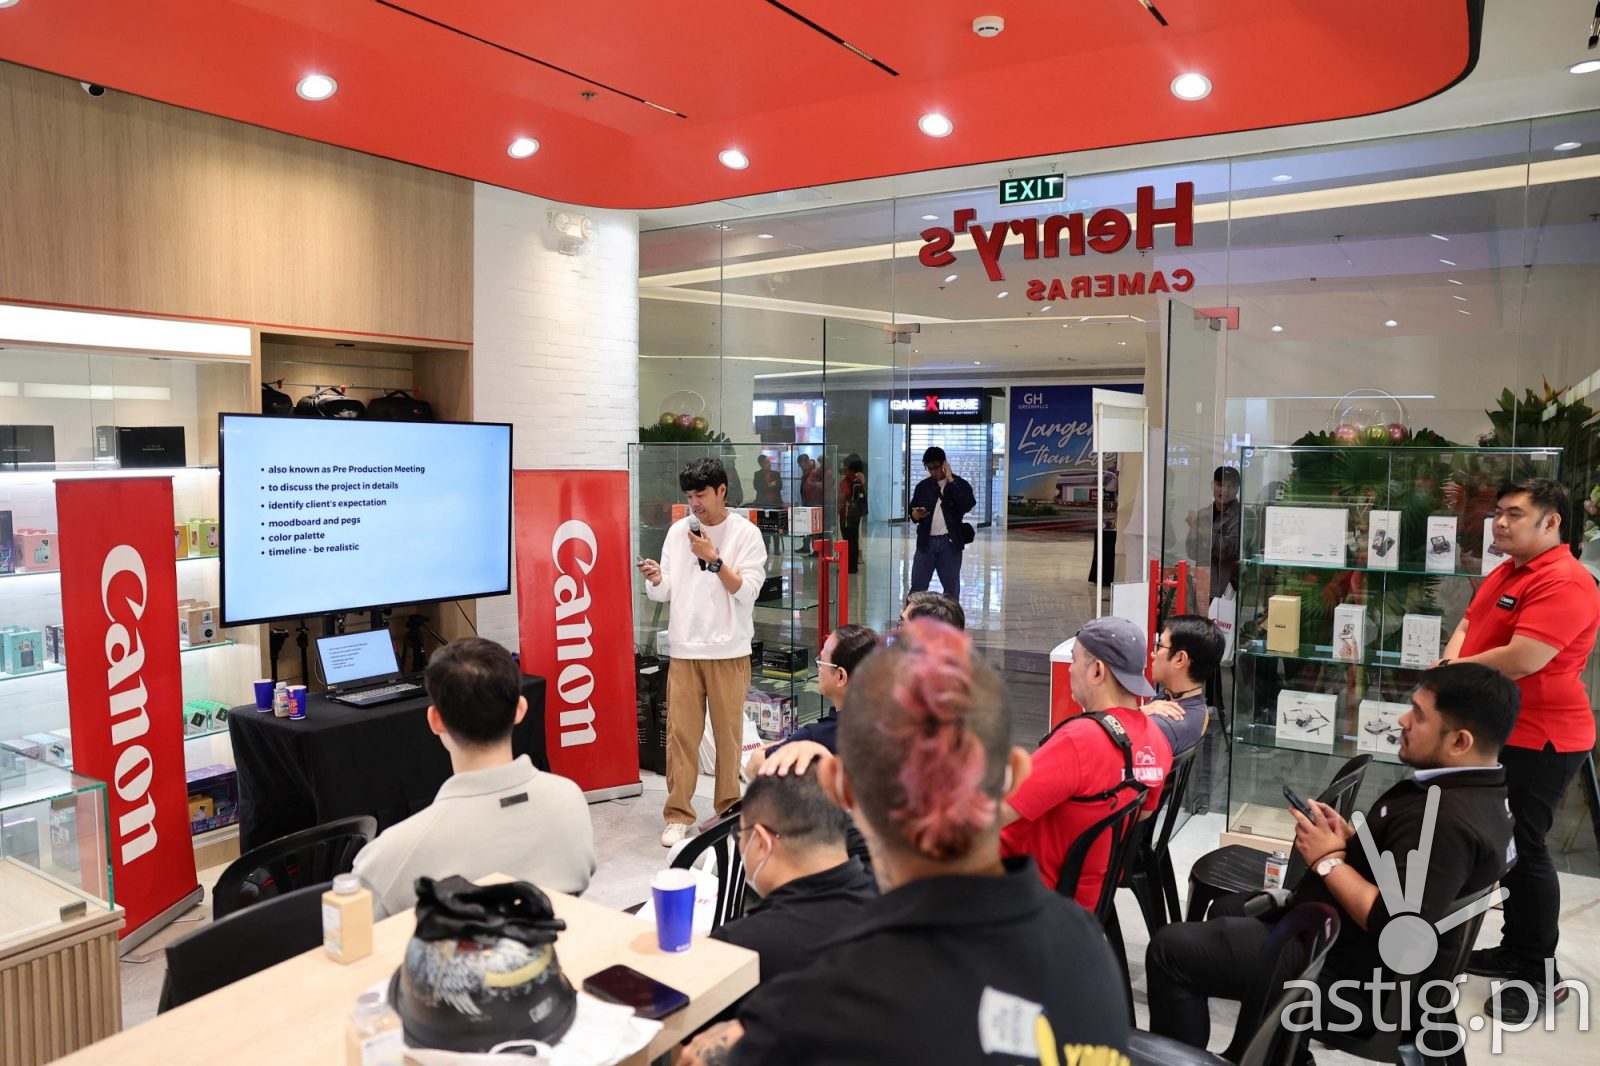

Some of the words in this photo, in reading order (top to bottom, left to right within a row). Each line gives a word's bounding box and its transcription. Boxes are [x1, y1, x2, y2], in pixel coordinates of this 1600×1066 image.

[1005, 177, 1062, 201] EXIT
[1023, 393, 1042, 405] GH
[268, 465, 287, 474] also
[289, 465, 320, 474] known
[333, 465, 347, 473] Pre
[348, 464, 393, 473] Production
[394, 464, 426, 474] Meeting
[268, 484, 278, 492] to
[280, 482, 313, 491] discuss
[315, 482, 329, 491] the
[331, 481, 361, 492] project
[362, 481, 371, 490] in
[372, 481, 399, 490] details
[268, 500, 304, 511] identify
[305, 499, 337, 509] client's
[338, 498, 387, 509] expectation
[268, 517, 321, 528] moodboard
[323, 516, 340, 526] and
[341, 516, 361, 525] pegs
[268, 532, 292, 542] color
[294, 531, 325, 542] palette
[268, 545, 307, 557] timeline
[313, 544, 325, 553] be
[326, 542, 360, 552] realistic
[552, 519, 598, 748] Canon
[101, 544, 159, 866] Canon
